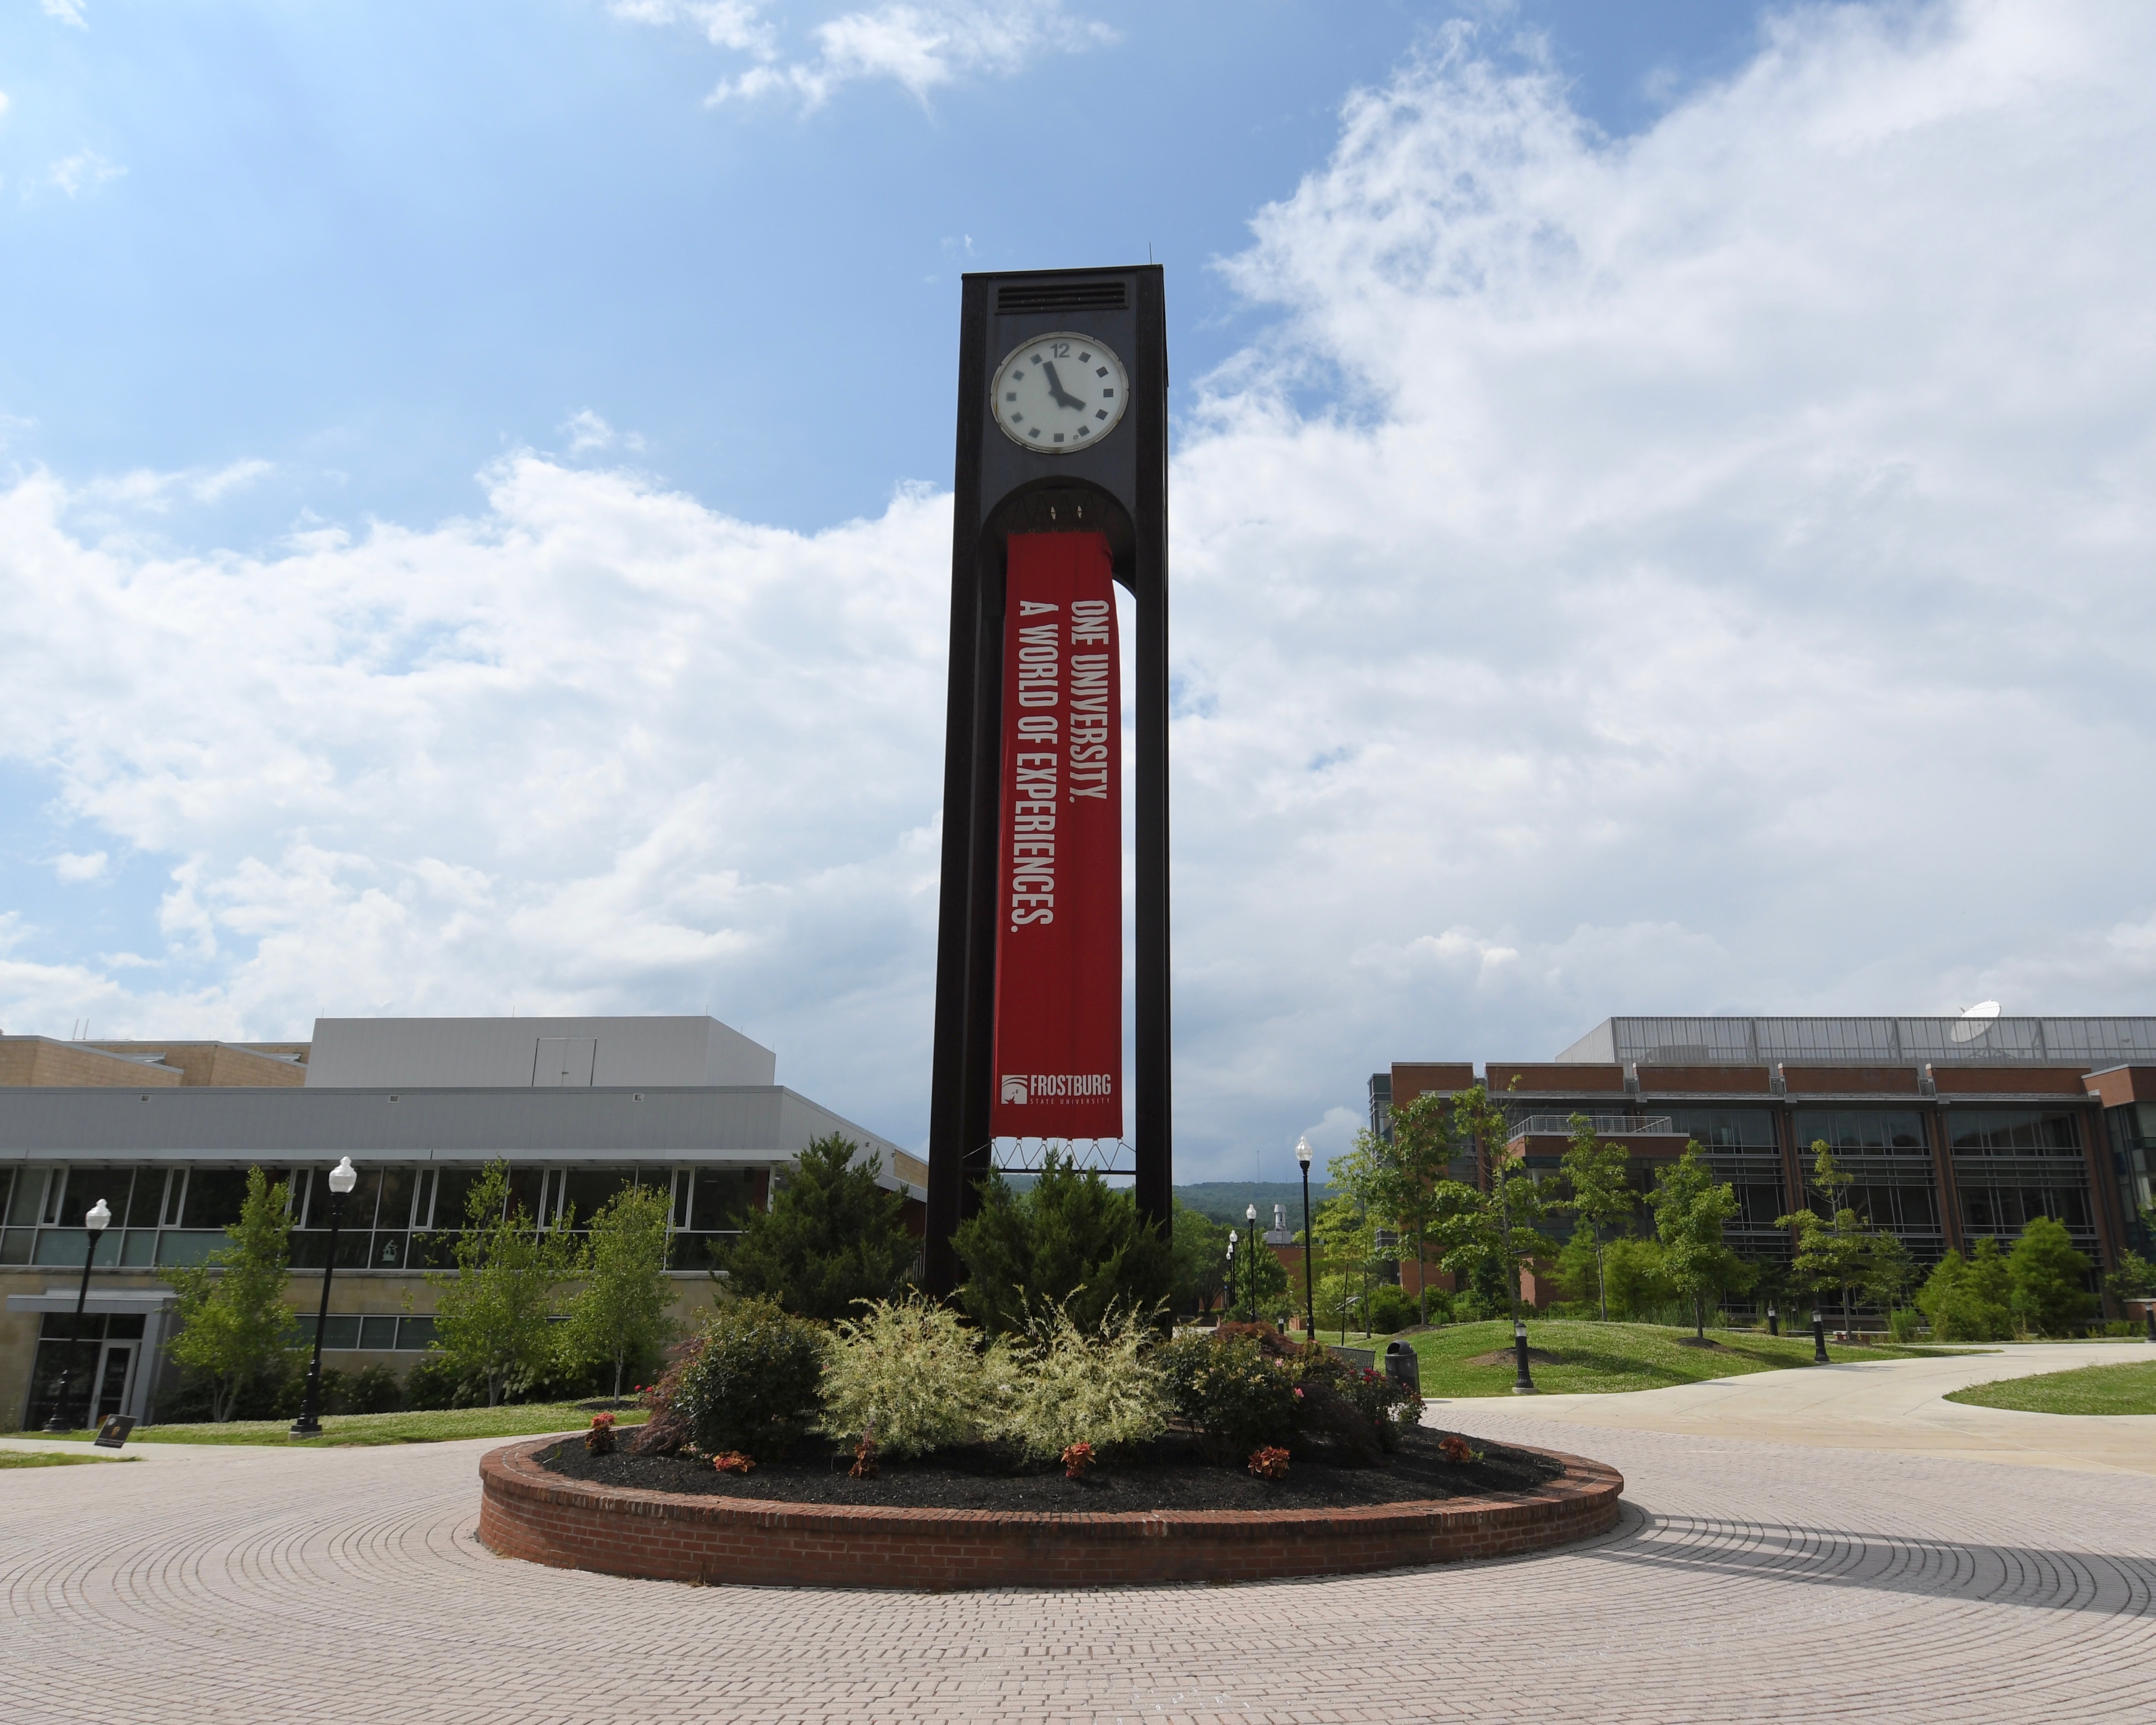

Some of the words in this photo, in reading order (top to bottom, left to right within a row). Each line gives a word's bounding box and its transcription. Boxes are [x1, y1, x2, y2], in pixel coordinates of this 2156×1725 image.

[1050, 343, 1070, 358] 12
[1020, 600, 1059, 616] A
[1071, 600, 1109, 645] ONE
[1019, 623, 1058, 707] WORLD
[1017, 716, 1058, 744] OF
[1069, 654, 1109, 803] UNIVERSITY.
[1011, 753, 1057, 933] EXPERIENCES.
[1030, 1074, 1111, 1096] FROSTBURG
